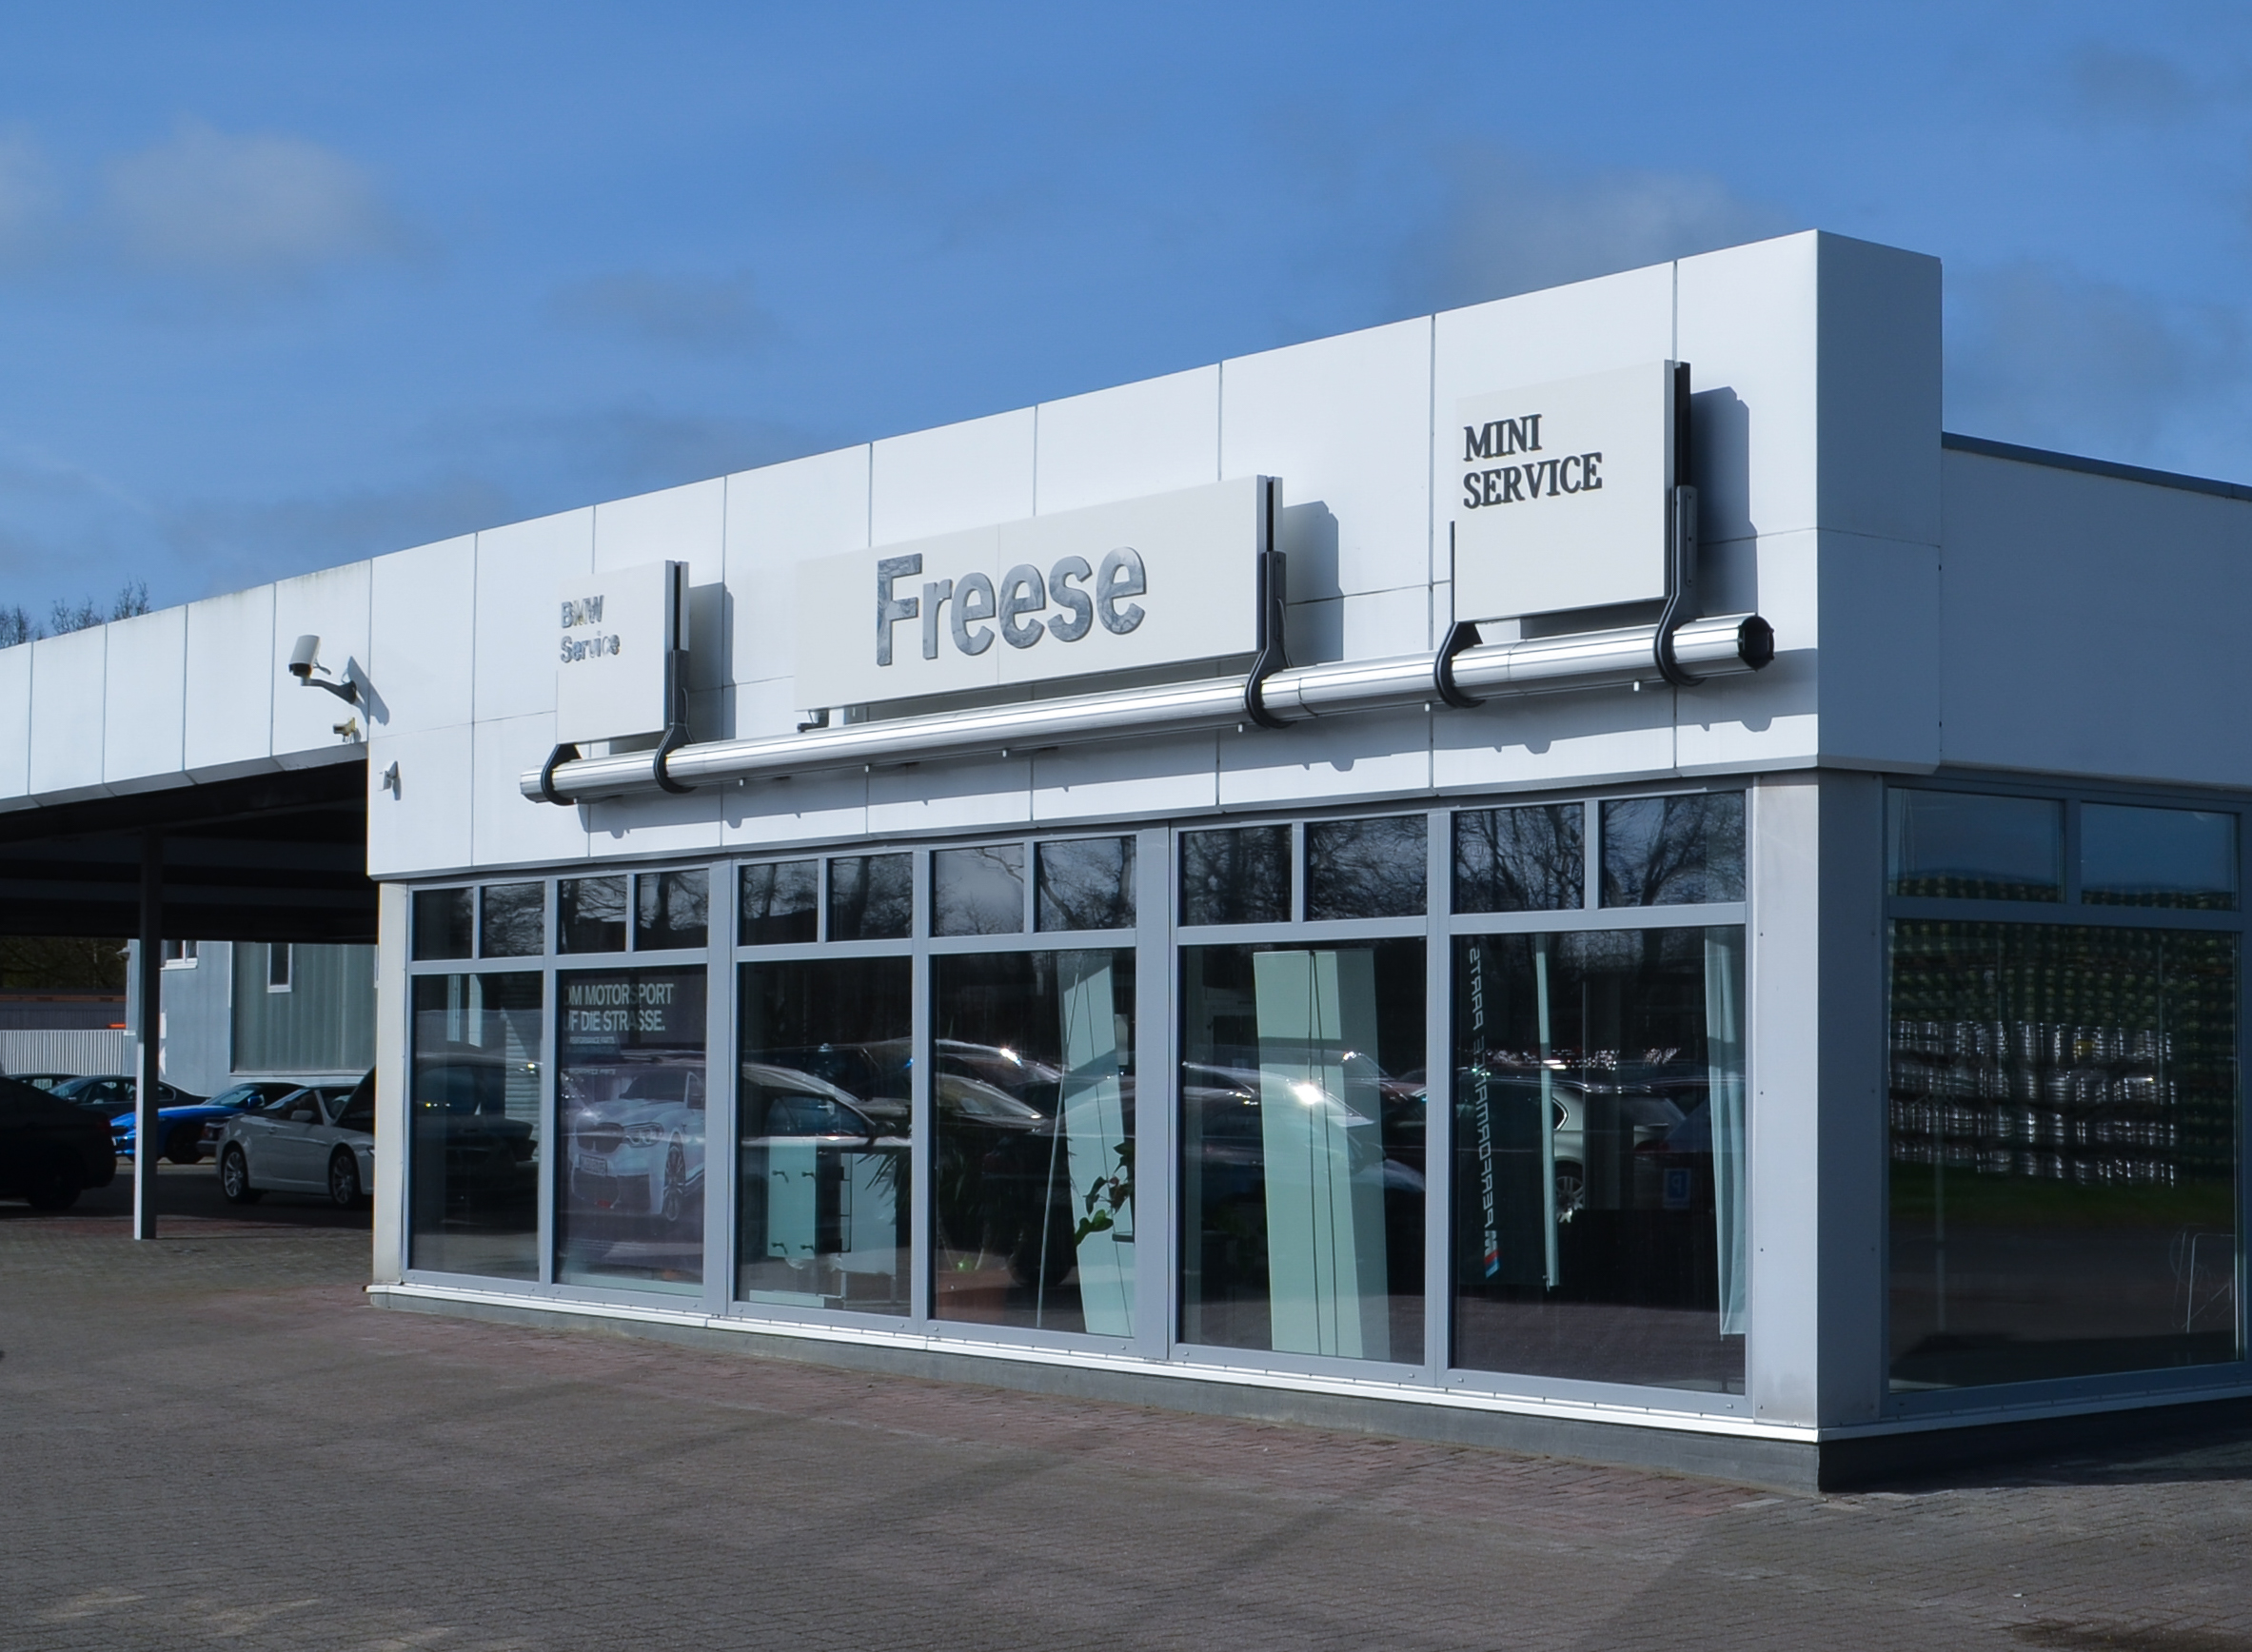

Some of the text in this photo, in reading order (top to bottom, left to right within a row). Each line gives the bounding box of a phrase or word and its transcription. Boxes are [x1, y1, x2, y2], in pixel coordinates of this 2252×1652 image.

[1463, 413, 1542, 462] MINI
[1463, 451, 1603, 509] SERVICE
[561, 594, 604, 628] BMW
[876, 545, 1147, 666] Freese
[560, 630, 620, 663] Service
[581, 1010, 602, 1032] DIE
